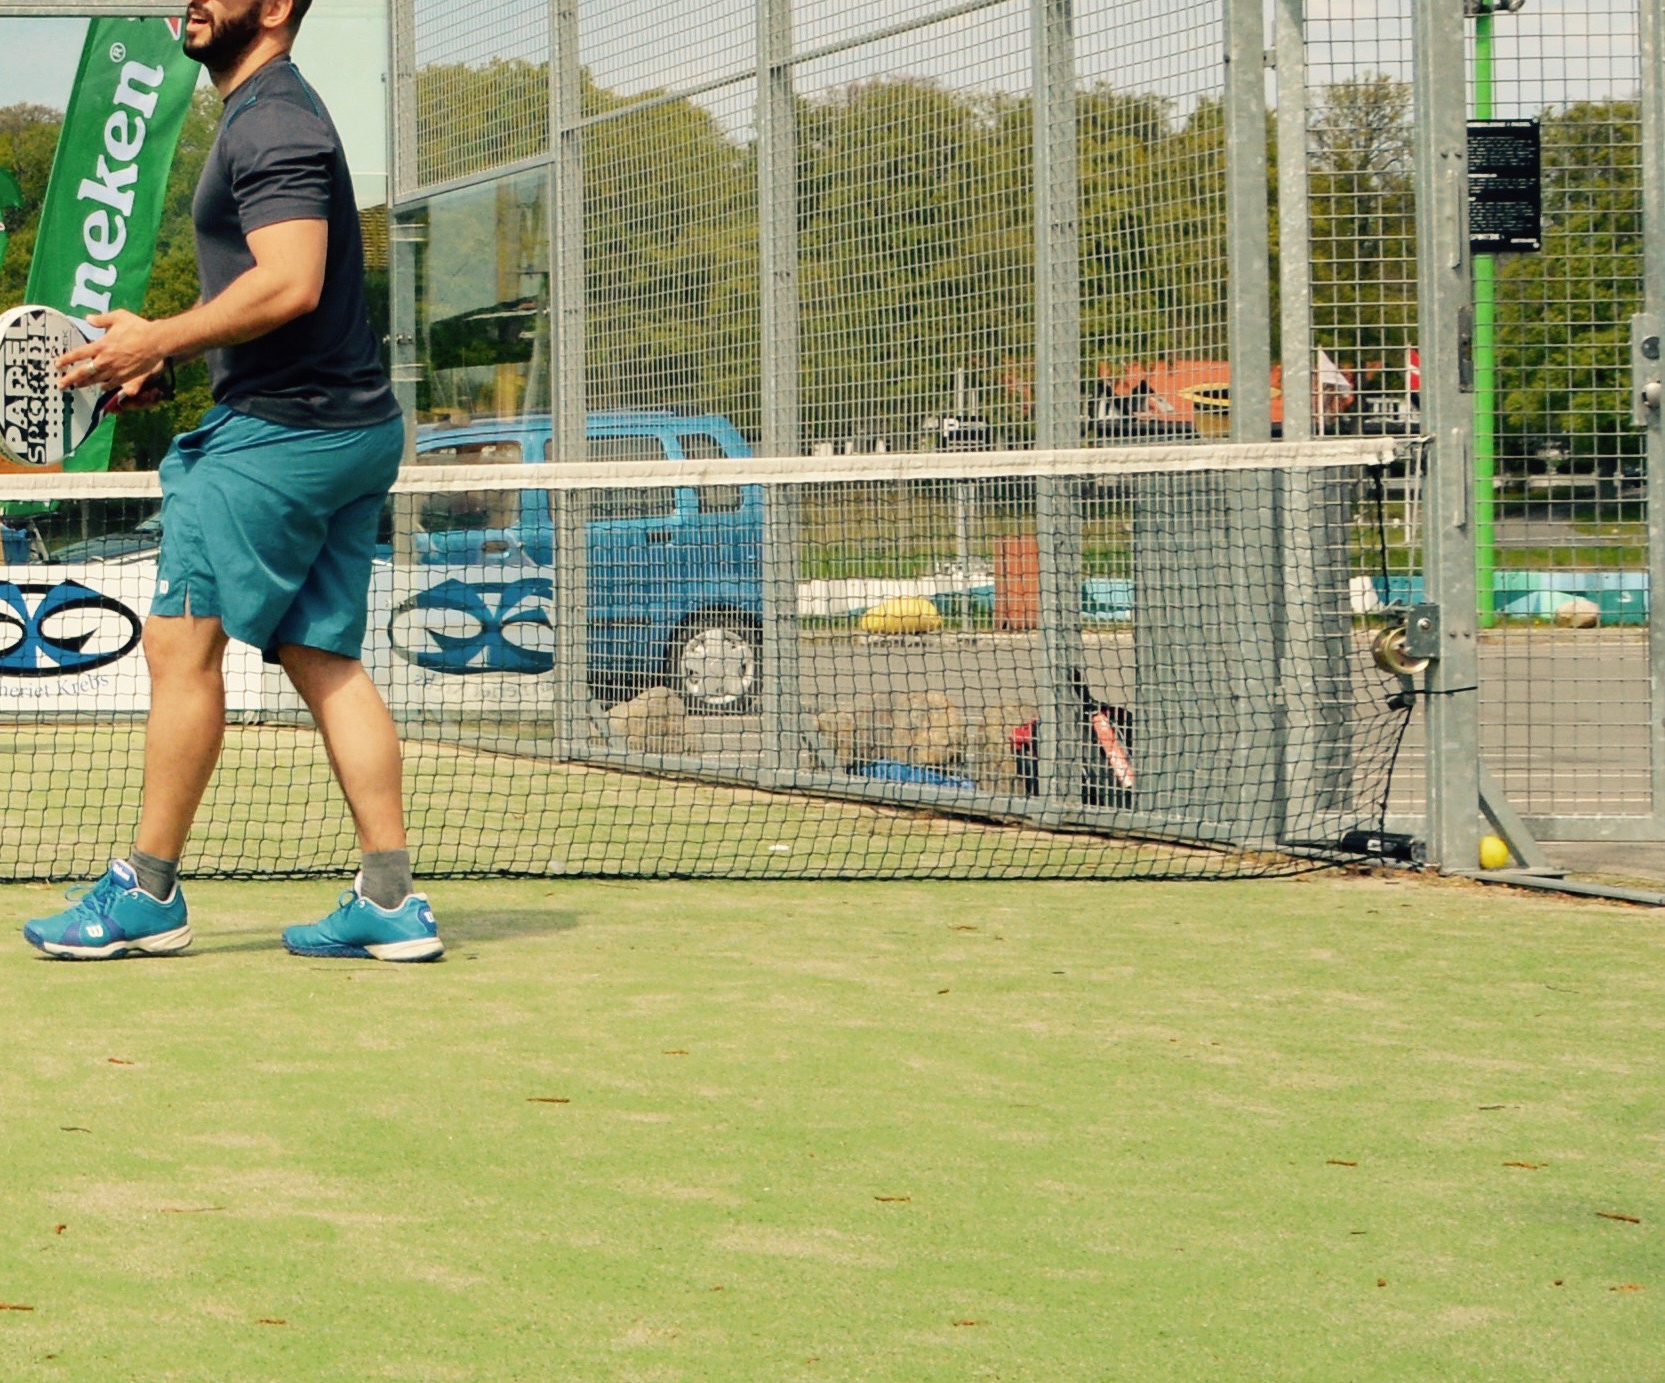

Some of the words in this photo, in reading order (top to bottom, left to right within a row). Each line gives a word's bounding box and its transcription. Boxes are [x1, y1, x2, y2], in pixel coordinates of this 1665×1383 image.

[70, 60, 165, 328] neken
[5, 316, 28, 454] PADEL
[56, 672, 111, 696] Krebs
